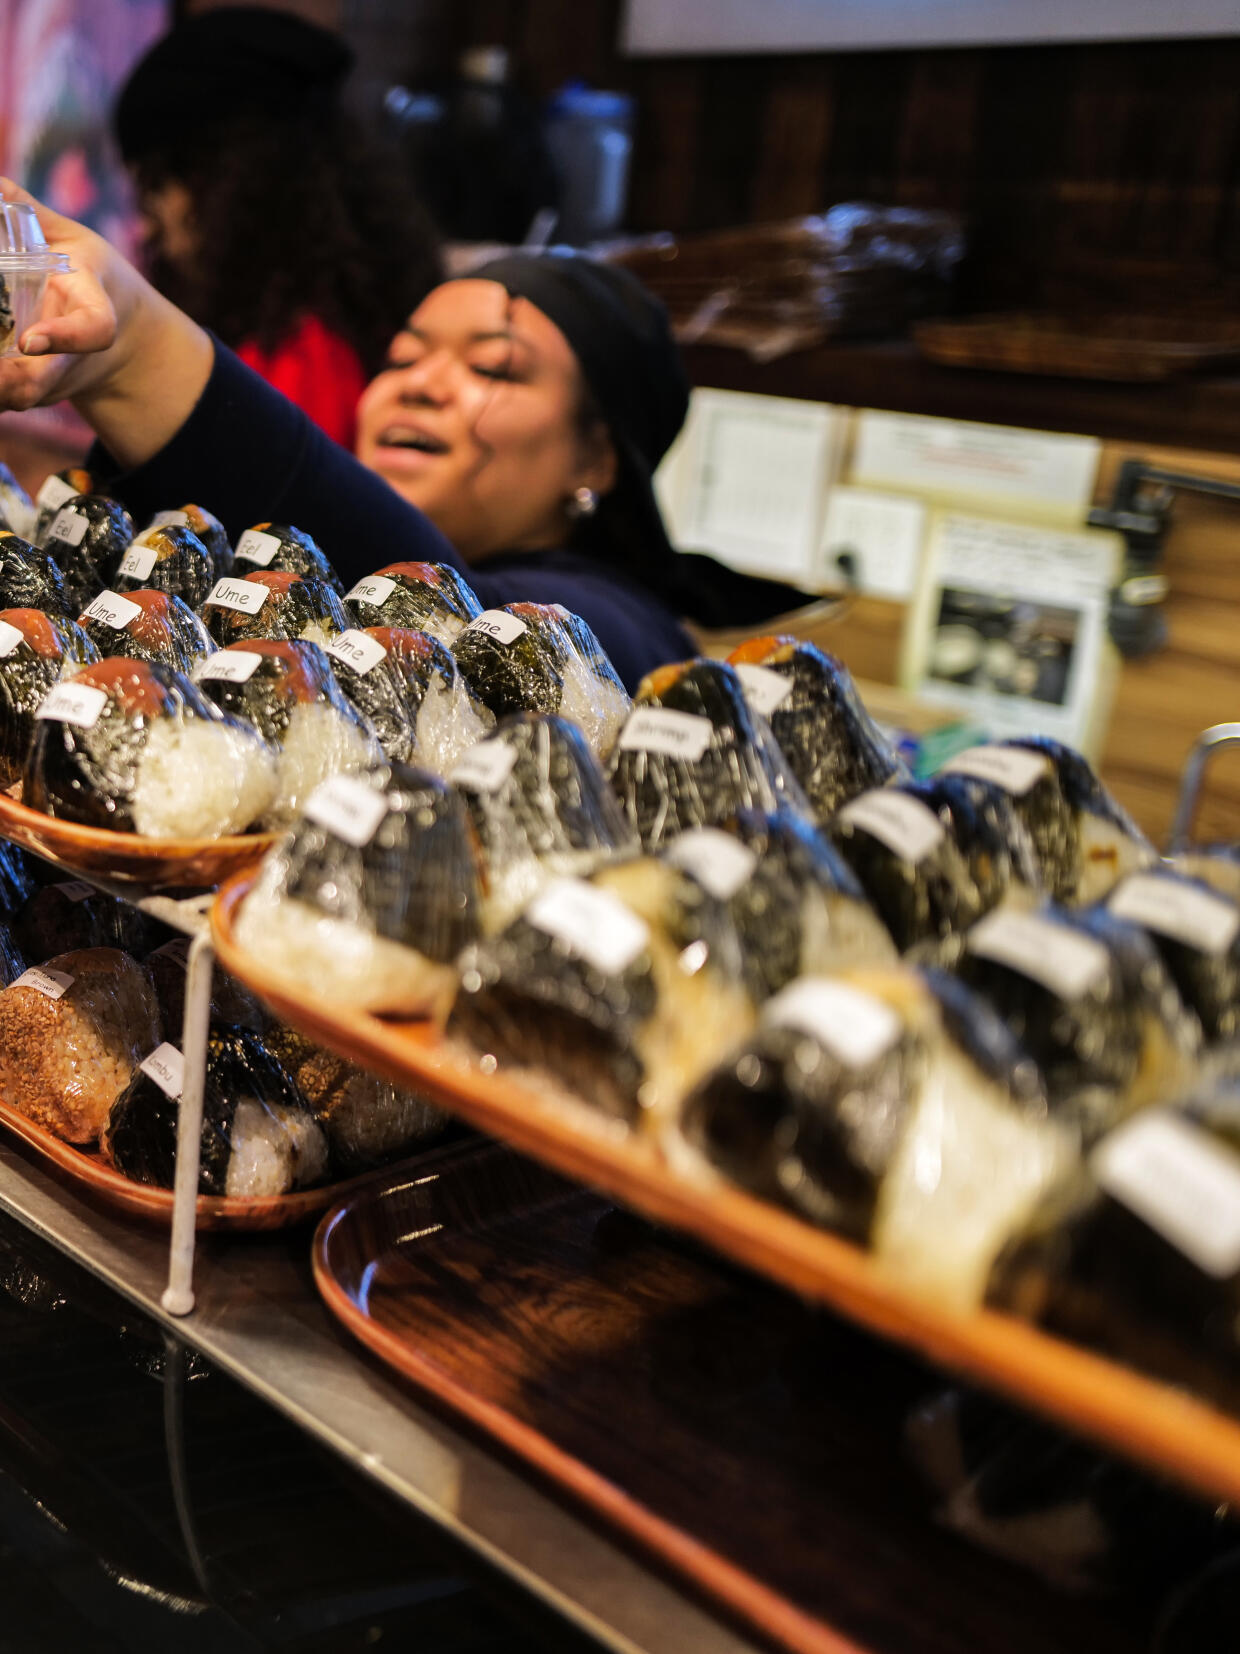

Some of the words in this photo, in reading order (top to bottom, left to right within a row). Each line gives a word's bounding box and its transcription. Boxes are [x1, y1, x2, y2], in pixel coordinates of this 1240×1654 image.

[214, 584, 250, 605] Ume
[88, 601, 117, 622] Ume
[330, 633, 365, 661] Ume
